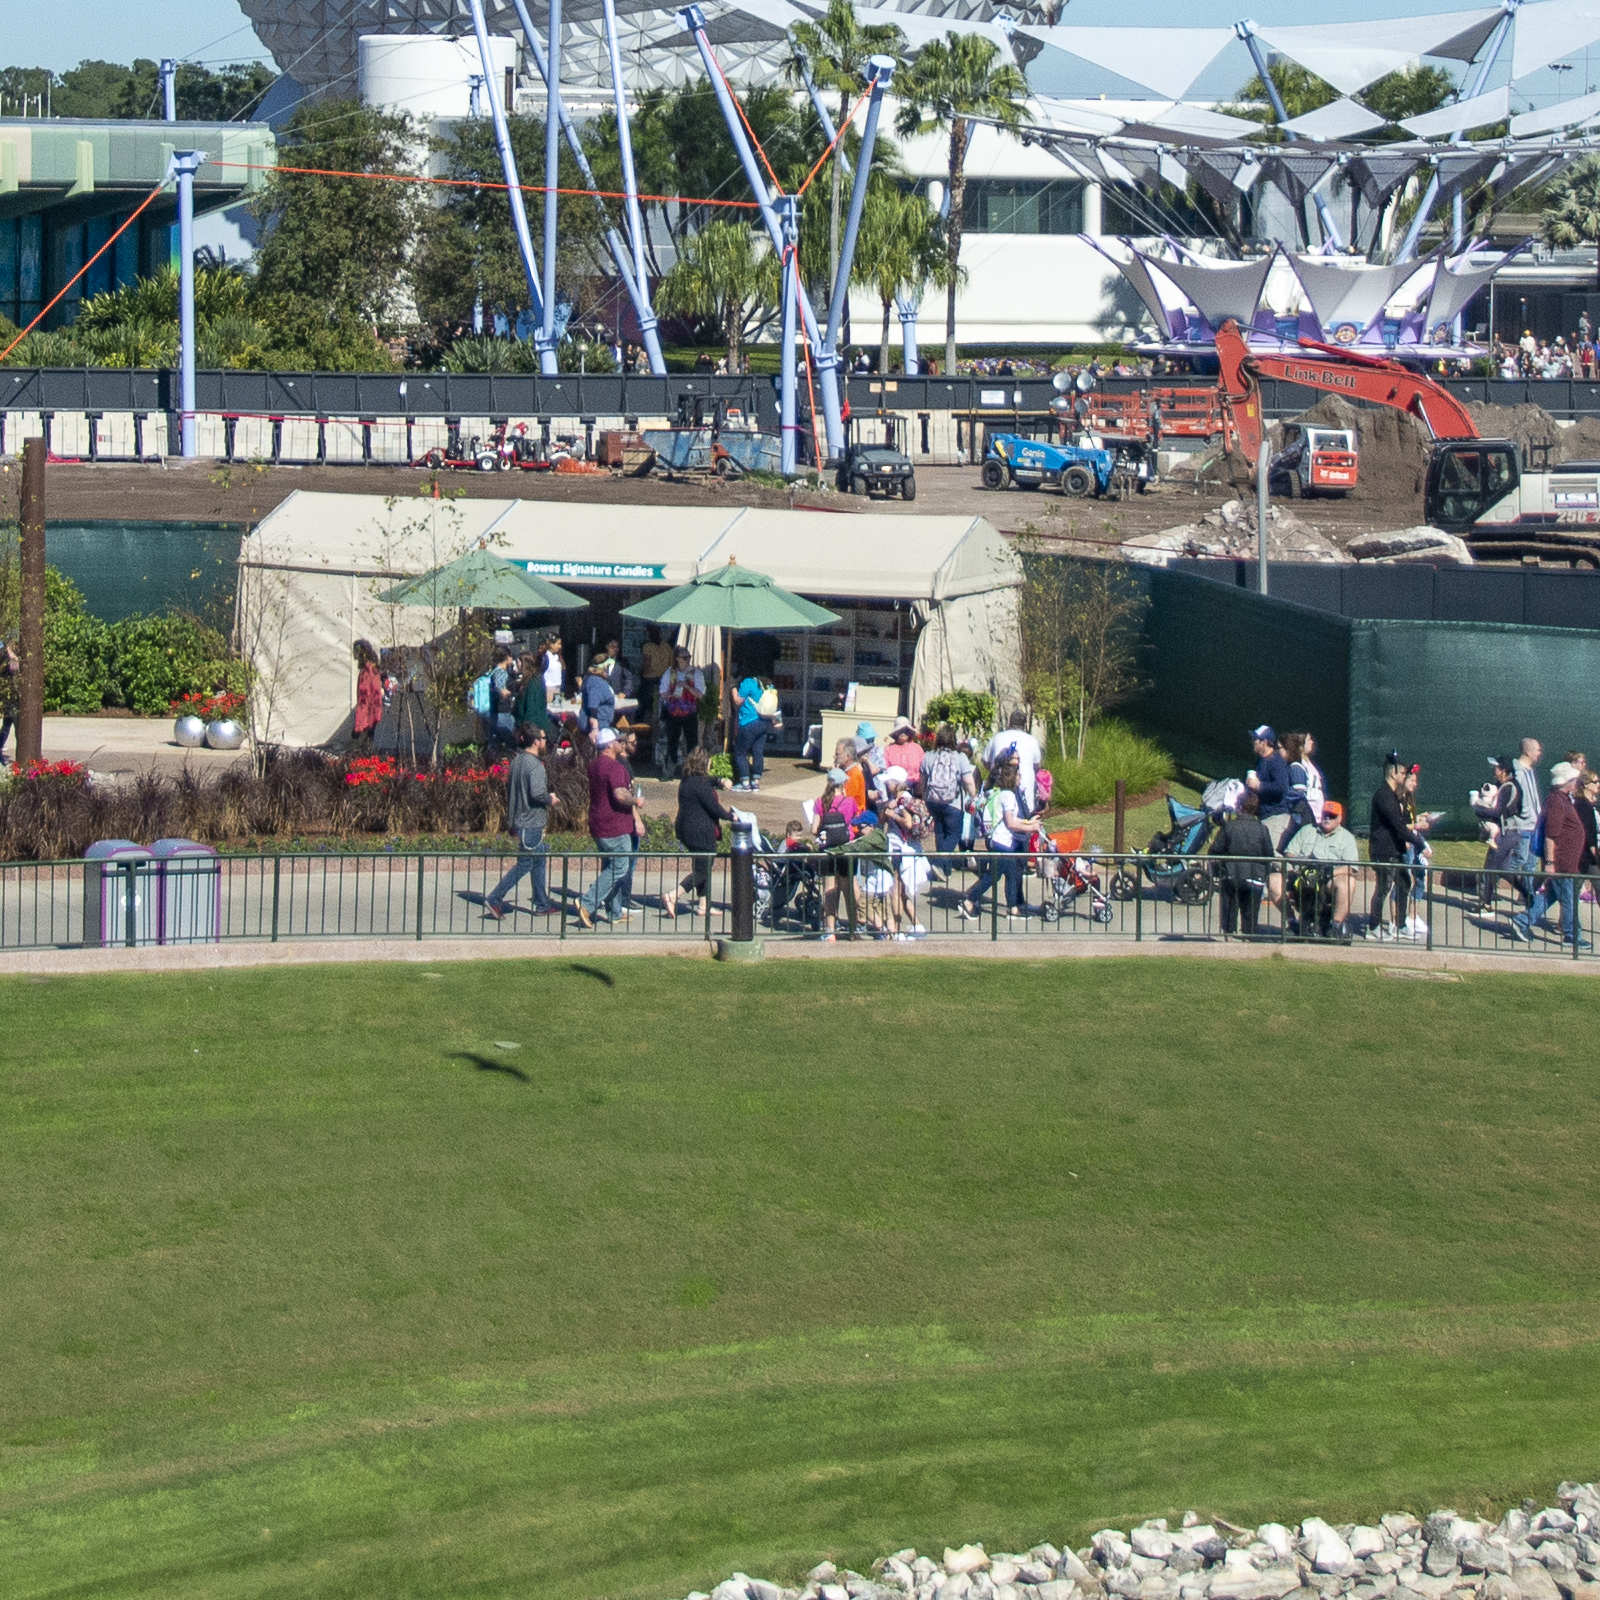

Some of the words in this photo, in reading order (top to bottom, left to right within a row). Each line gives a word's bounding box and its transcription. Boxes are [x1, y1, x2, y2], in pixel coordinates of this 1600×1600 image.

[526, 561, 561, 573] Bowes
[562, 563, 612, 576] Signature
[613, 565, 654, 577] Candles
